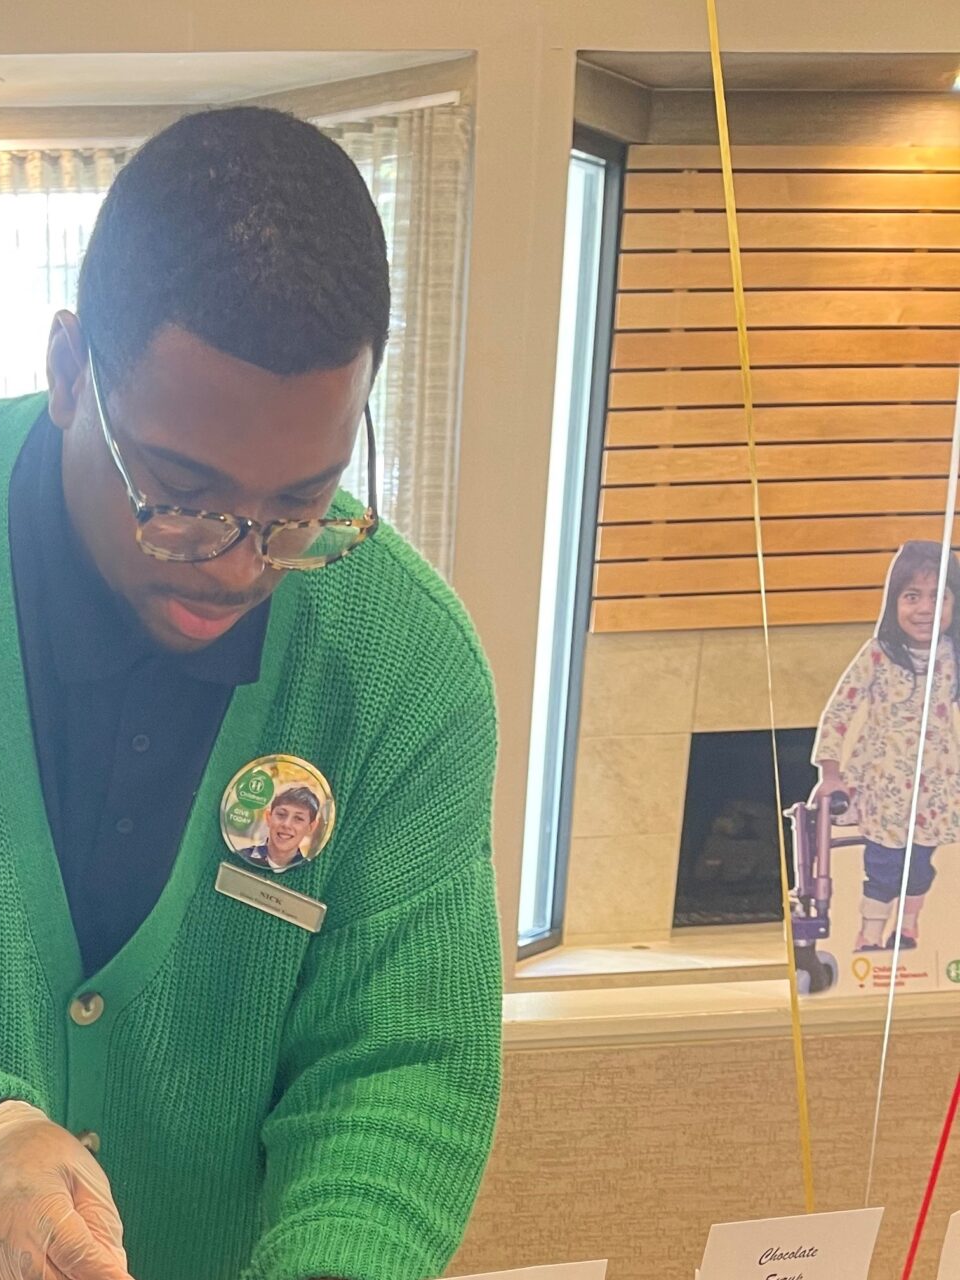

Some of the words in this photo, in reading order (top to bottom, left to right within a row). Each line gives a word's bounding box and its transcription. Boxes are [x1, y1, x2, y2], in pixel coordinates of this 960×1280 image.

[234, 808, 249, 816] GIVE
[230, 814, 251, 824] TODAY
[758, 1245, 819, 1267] Chocolate
